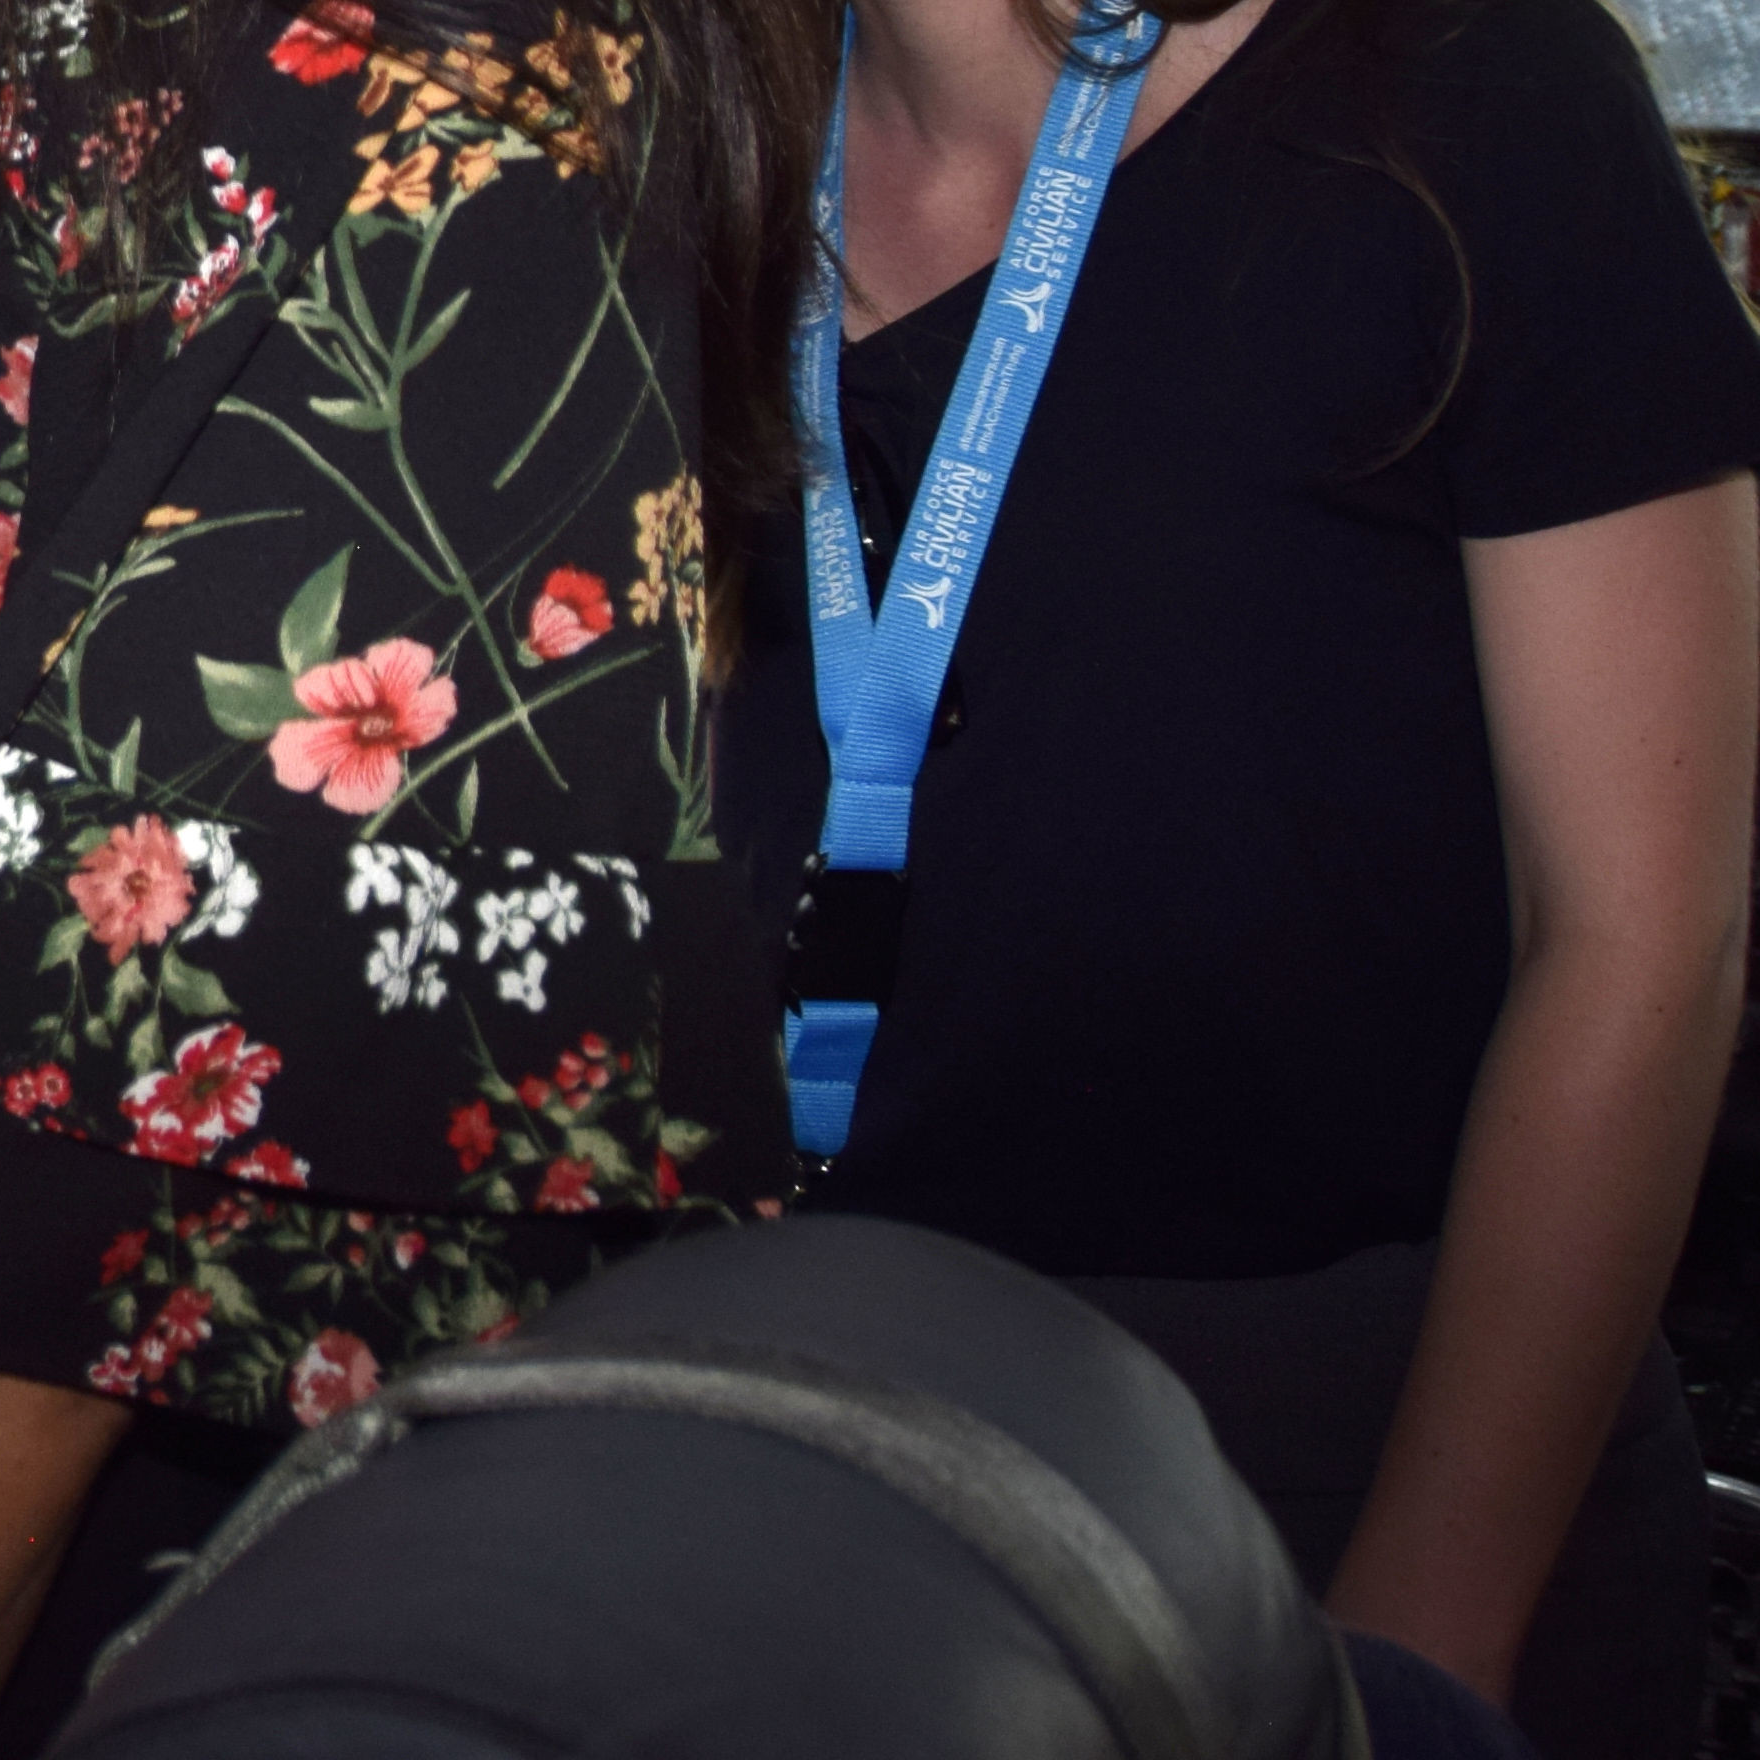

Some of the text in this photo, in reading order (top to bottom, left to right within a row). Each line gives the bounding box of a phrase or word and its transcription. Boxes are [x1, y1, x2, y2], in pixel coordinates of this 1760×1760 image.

[1008, 165, 1054, 269] AIR FORCE
[1023, 168, 1077, 274] CIVILIAN
[1046, 176, 1094, 281] SERVICE
[909, 456, 956, 564] AIR FORCE
[923, 461, 979, 570] CIVILIAN
[945, 468, 993, 576] SERVICE
[821, 510, 849, 619] CIVILIAN
